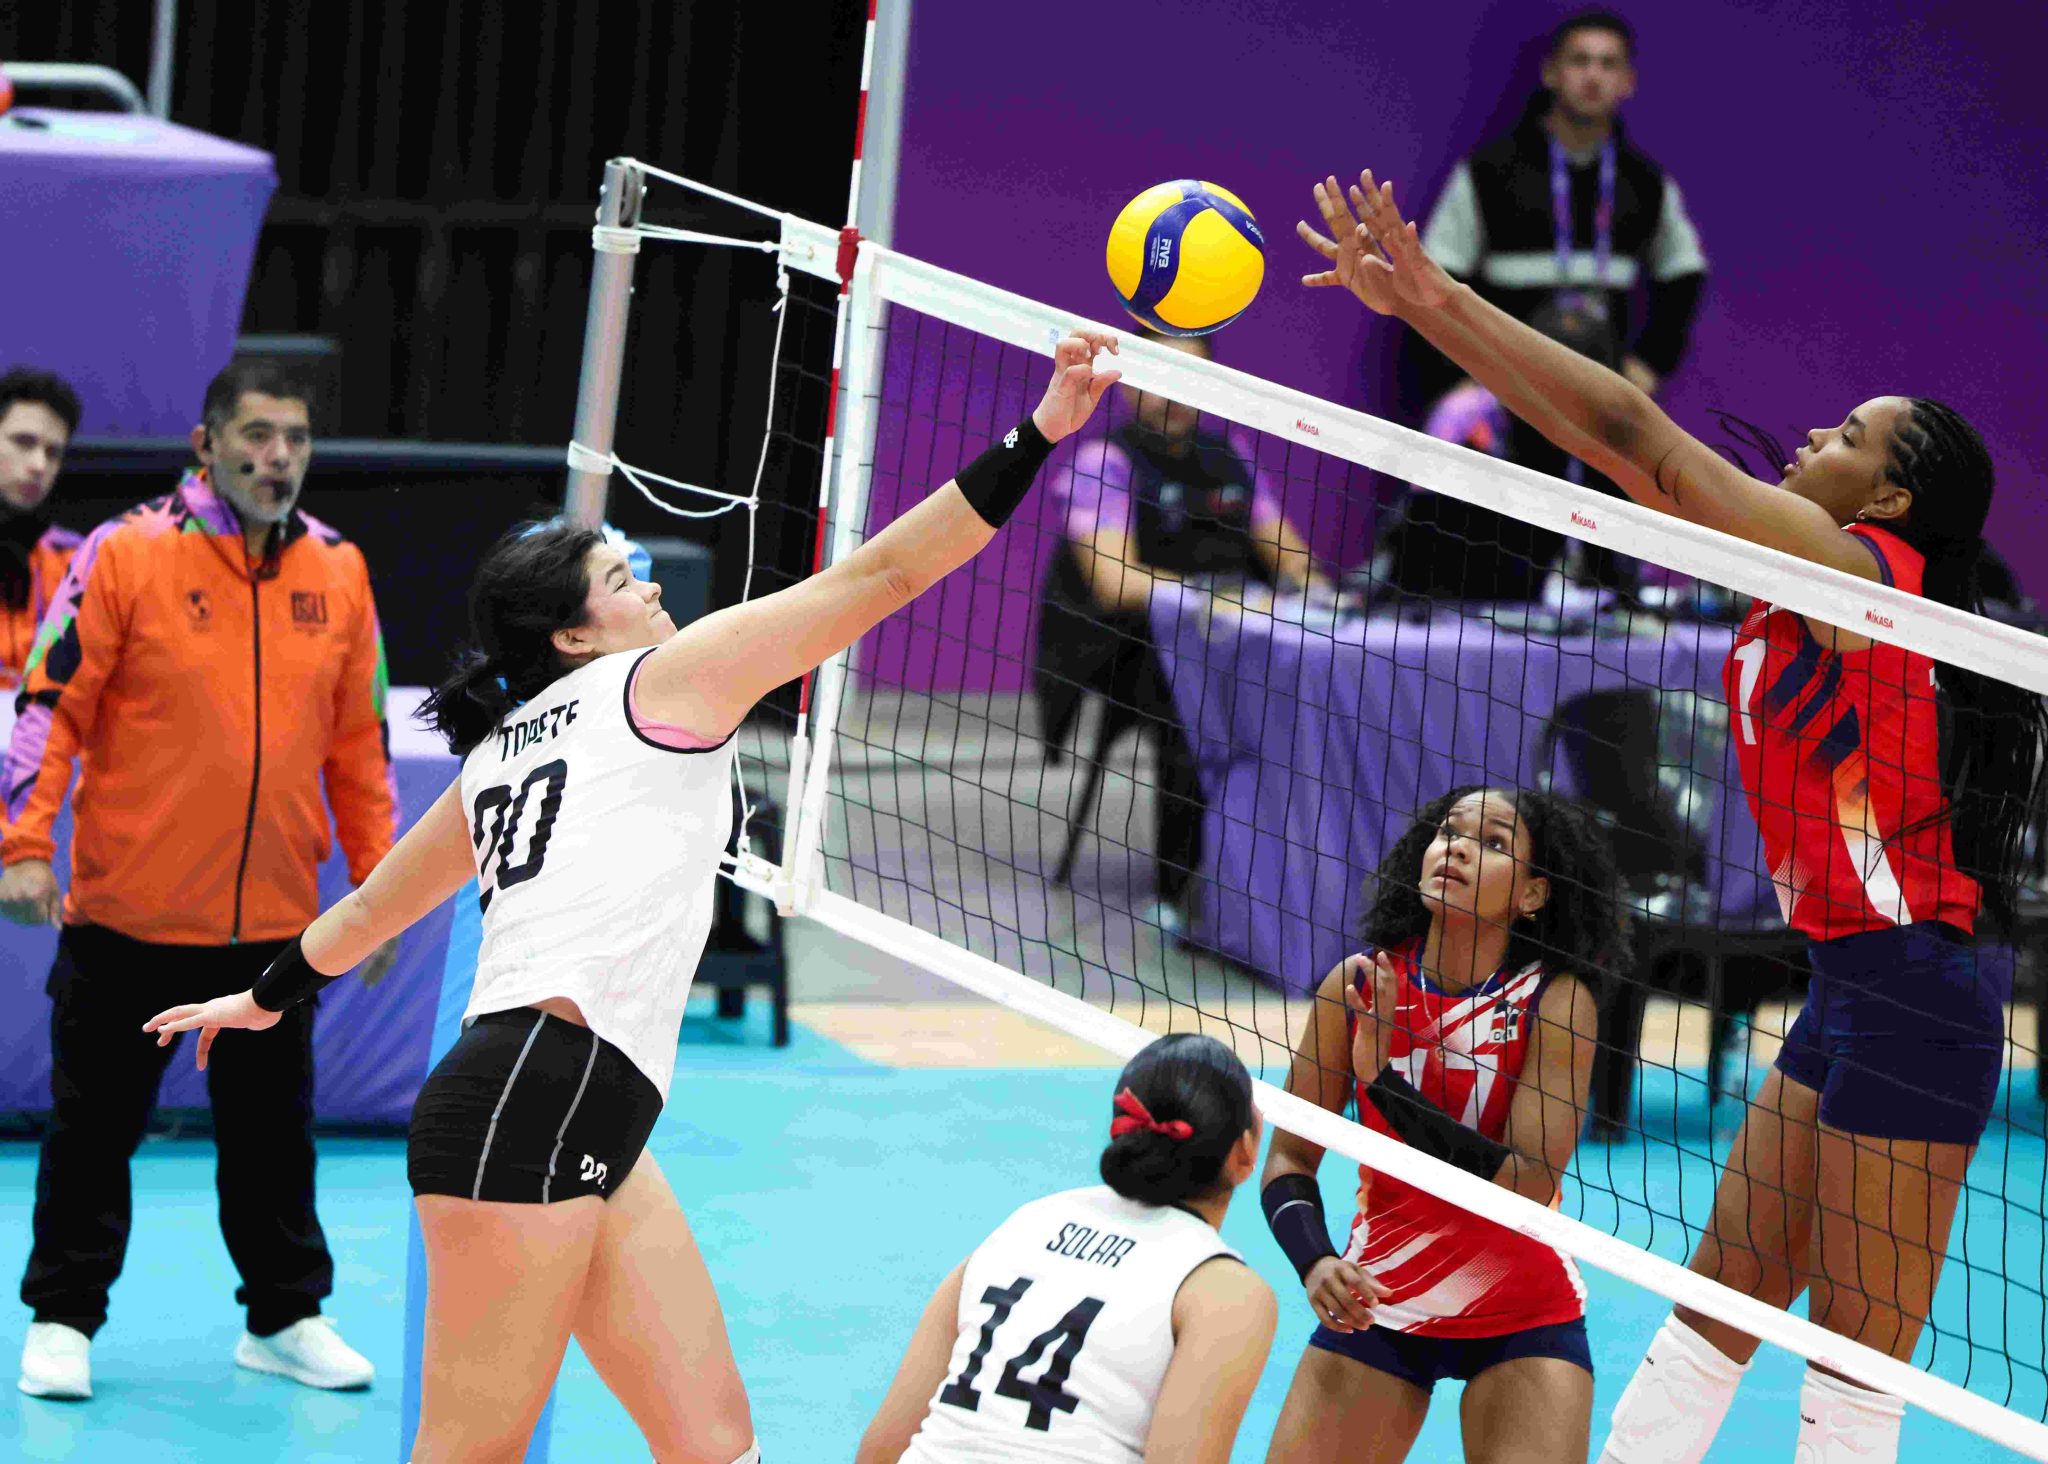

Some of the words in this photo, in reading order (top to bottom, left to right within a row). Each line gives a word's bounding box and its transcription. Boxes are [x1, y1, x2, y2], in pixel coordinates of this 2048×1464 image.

[1158, 238, 1173, 269] FIVB
[474, 758, 568, 915] 20
[1046, 1222, 1136, 1268] SOLAR
[939, 1276, 1105, 1432] 14
